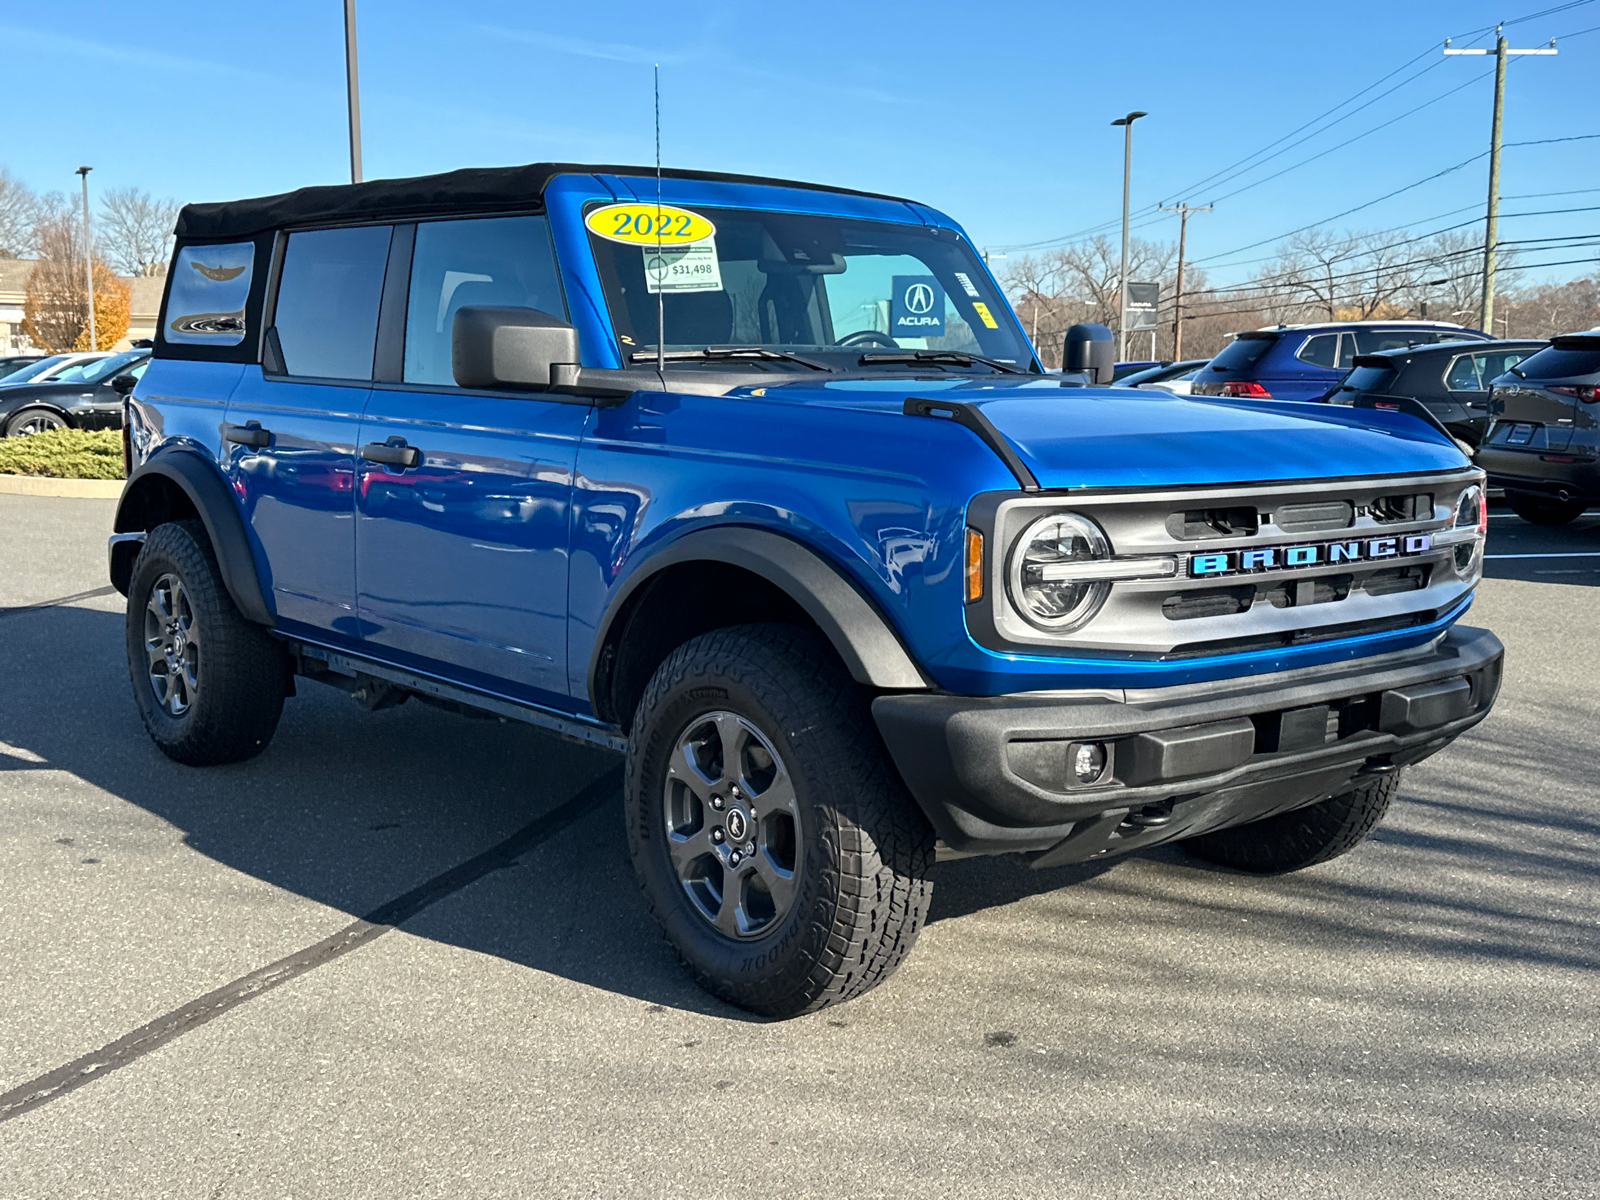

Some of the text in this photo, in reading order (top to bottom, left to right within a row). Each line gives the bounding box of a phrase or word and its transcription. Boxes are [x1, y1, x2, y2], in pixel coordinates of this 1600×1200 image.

[613, 213, 692, 236] 2022
[672, 264, 712, 276] $31,498
[897, 316, 941, 326] ACURA
[1191, 535, 1431, 575] BRONCO
